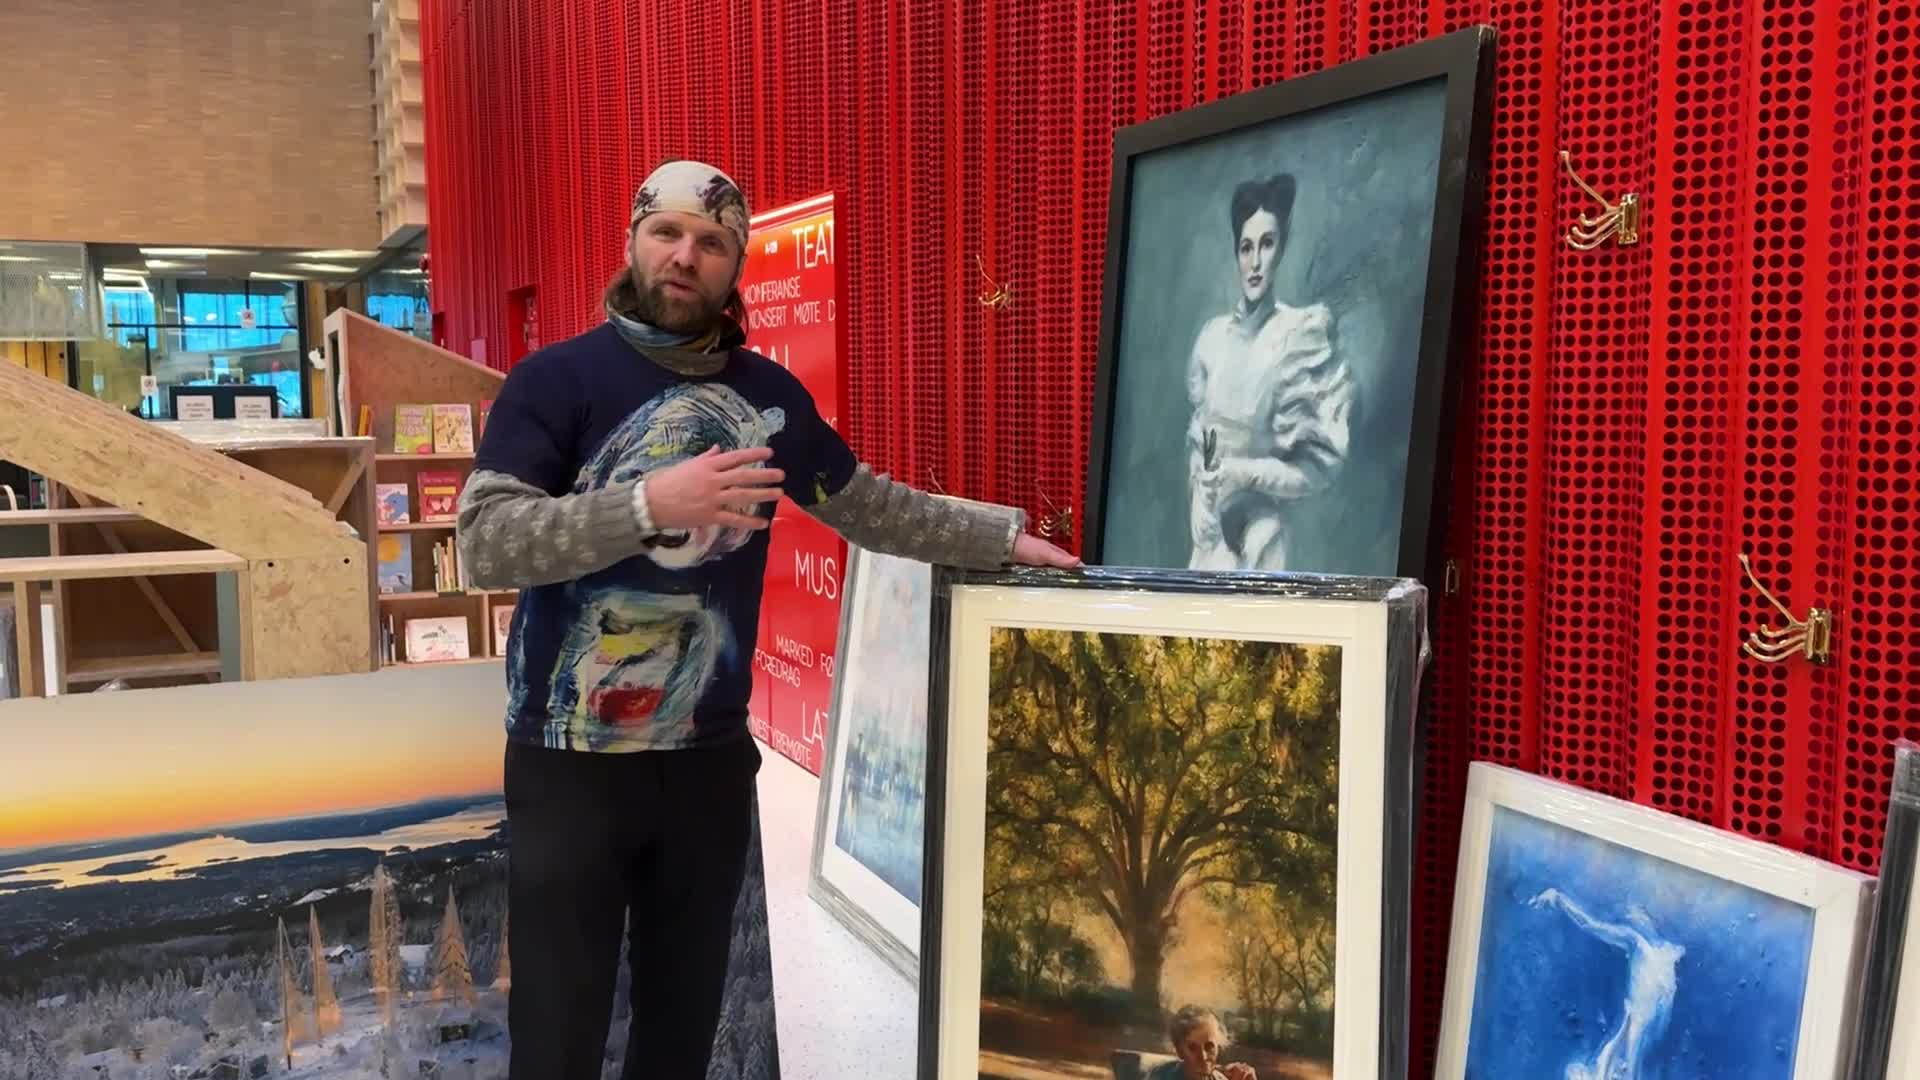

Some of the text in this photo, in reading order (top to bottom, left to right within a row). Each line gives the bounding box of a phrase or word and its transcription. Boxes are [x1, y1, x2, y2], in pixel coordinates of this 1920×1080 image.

[793, 301, 821, 326] MØTE
[795, 549, 837, 600] MUS
[755, 648, 801, 688] FOREDRAG
[775, 634, 814, 668] MARKED
[802, 701, 829, 751] LA
